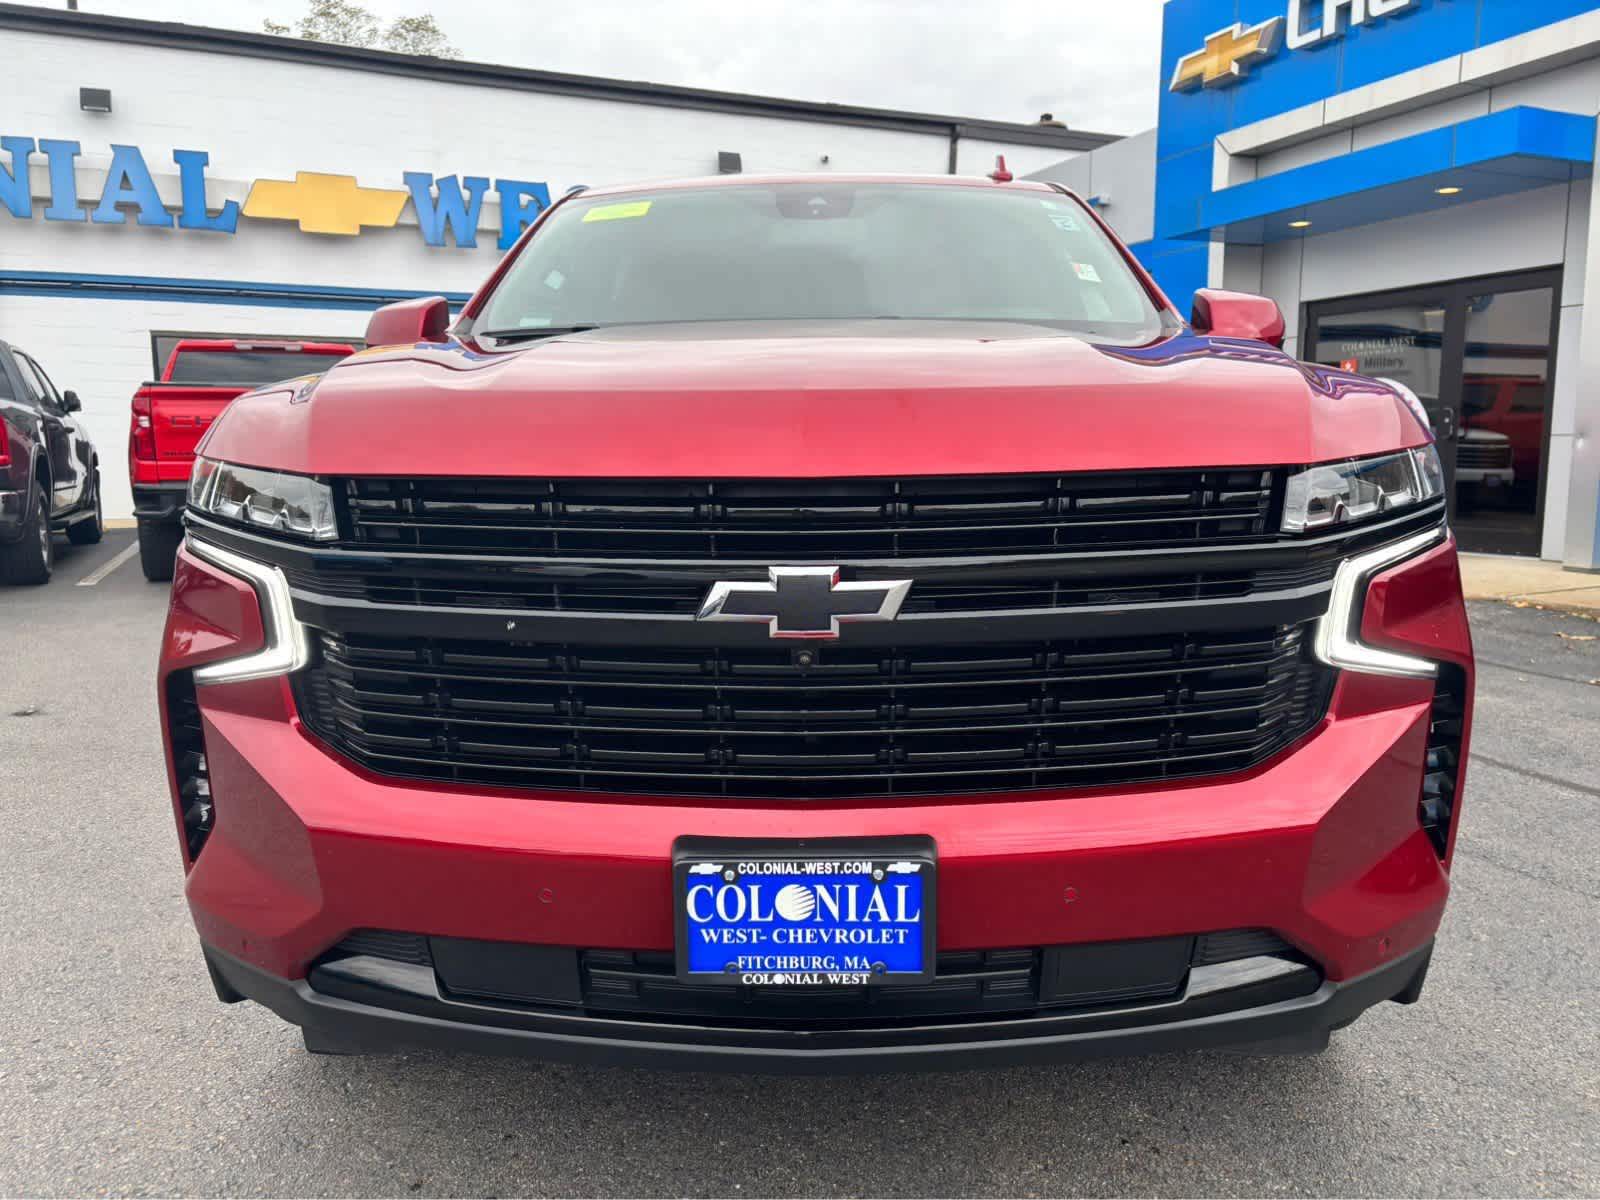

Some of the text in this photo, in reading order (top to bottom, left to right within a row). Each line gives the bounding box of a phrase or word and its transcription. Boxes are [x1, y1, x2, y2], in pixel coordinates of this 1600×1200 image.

[1286, 0, 1411, 50] CH
[0, 136, 240, 234] NIAL
[1389, 336, 1416, 347] WEST
[737, 862, 873, 875] COLONIAL-WEST.COM
[686, 883, 920, 923] COLONIAL
[772, 927, 909, 944] CHEVROLET
[737, 955, 871, 971] FITCHBURG, MA
[742, 972, 871, 985] COLONIAL WEST
